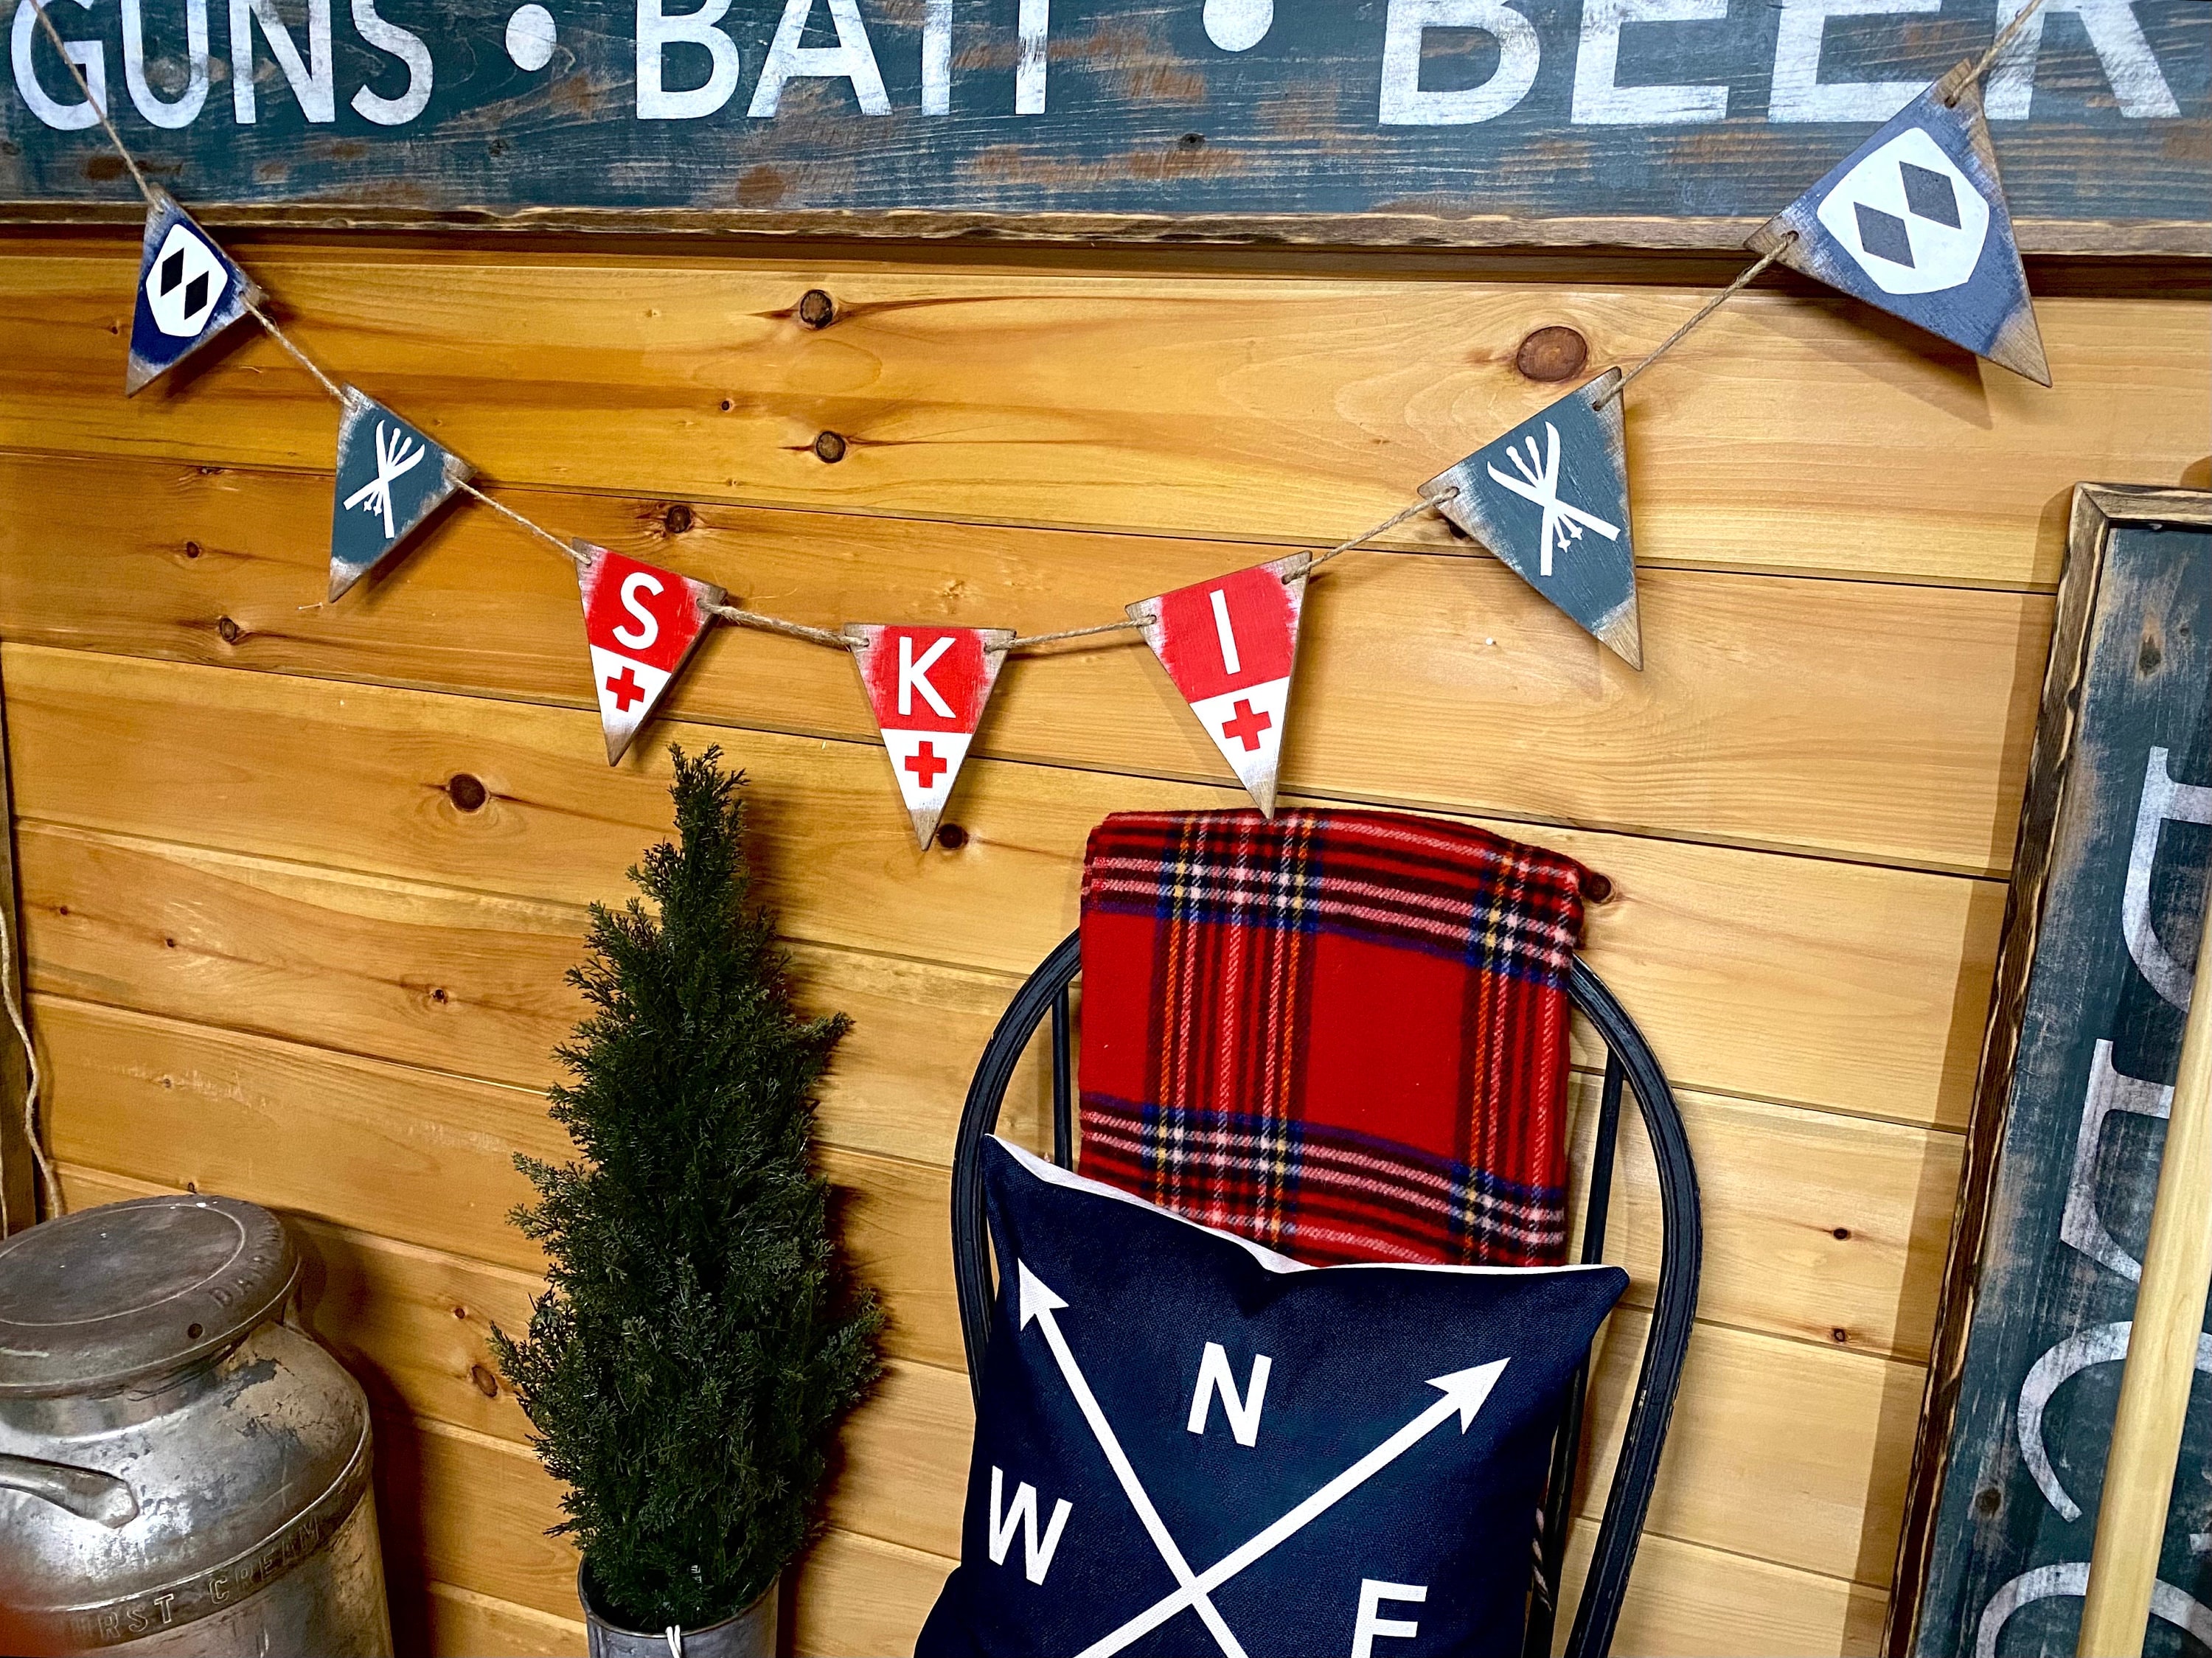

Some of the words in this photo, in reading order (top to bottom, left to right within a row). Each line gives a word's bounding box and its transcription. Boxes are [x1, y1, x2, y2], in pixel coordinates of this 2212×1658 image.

[10, 0, 434, 130] GUNS
[1186, 1341, 1273, 1448] N
[989, 1465, 1074, 1586] W
